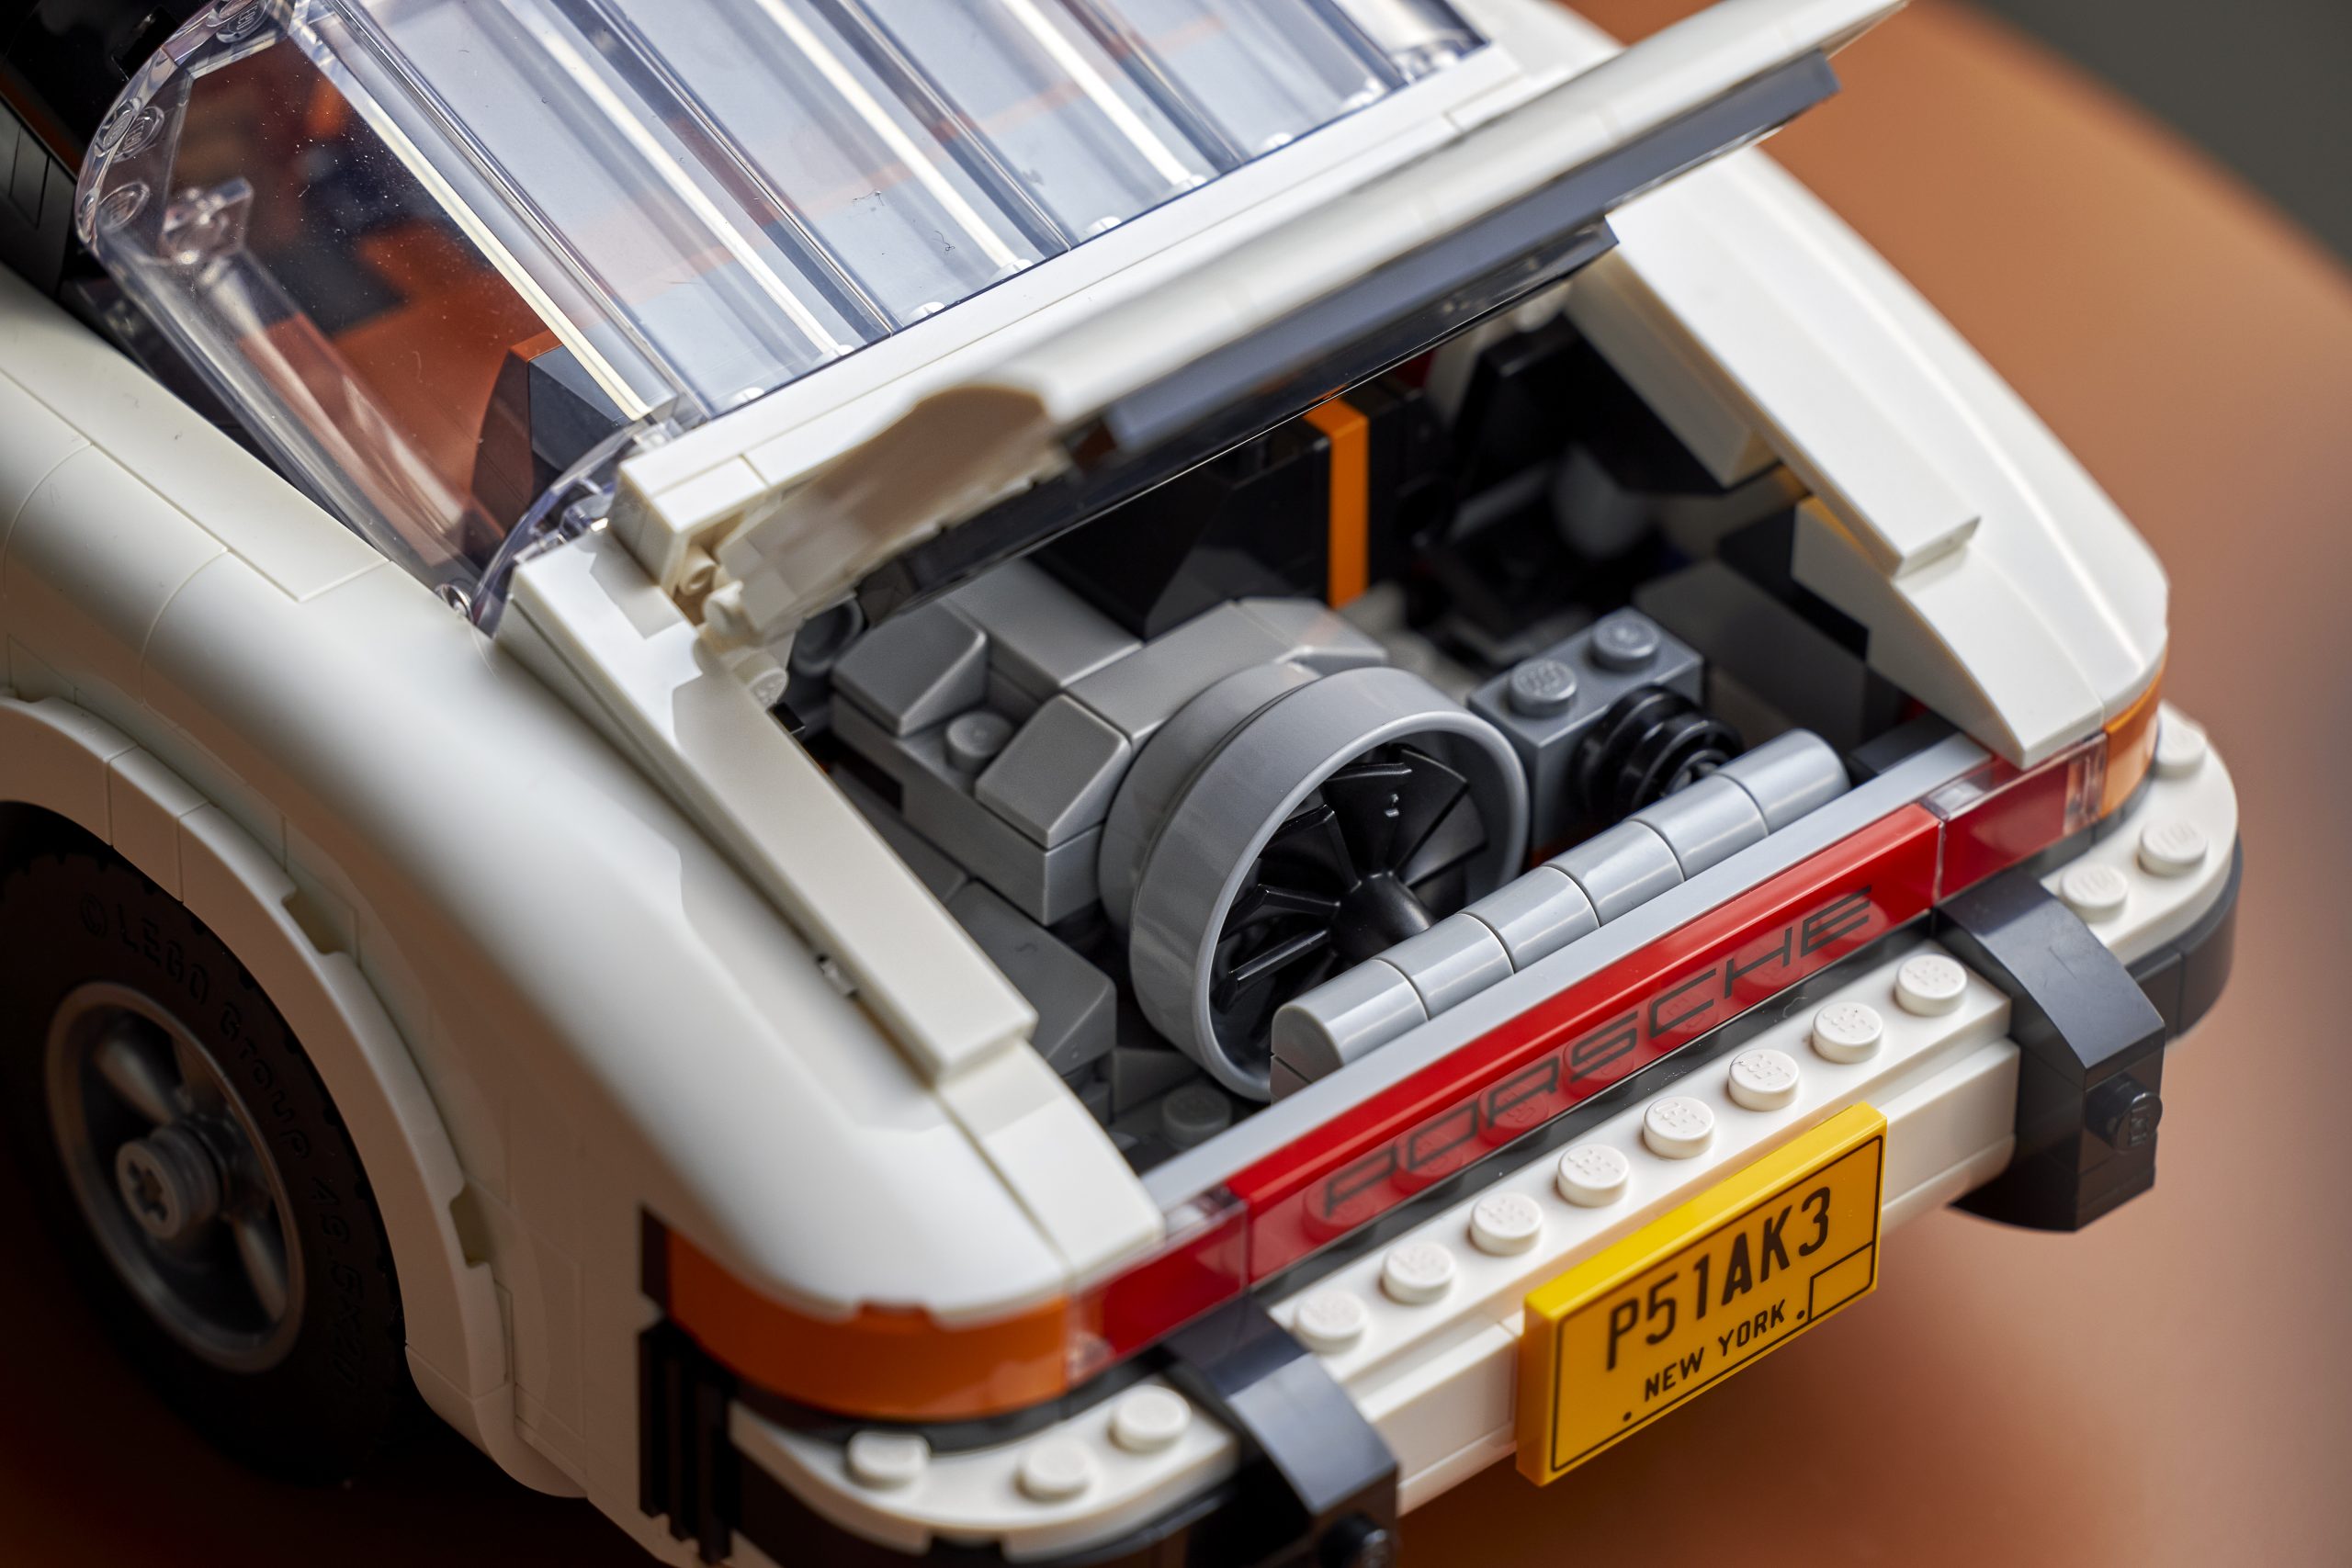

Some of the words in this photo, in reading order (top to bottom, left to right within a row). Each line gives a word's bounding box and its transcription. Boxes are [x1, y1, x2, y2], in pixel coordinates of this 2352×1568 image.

[220, 1001, 311, 1159] Group
[1325, 885, 1872, 1218] PORSCHE
[1607, 1186, 1830, 1371] P51AK3
[1645, 1347, 1704, 1402] NEW
[1718, 1298, 1785, 1357] YORK
